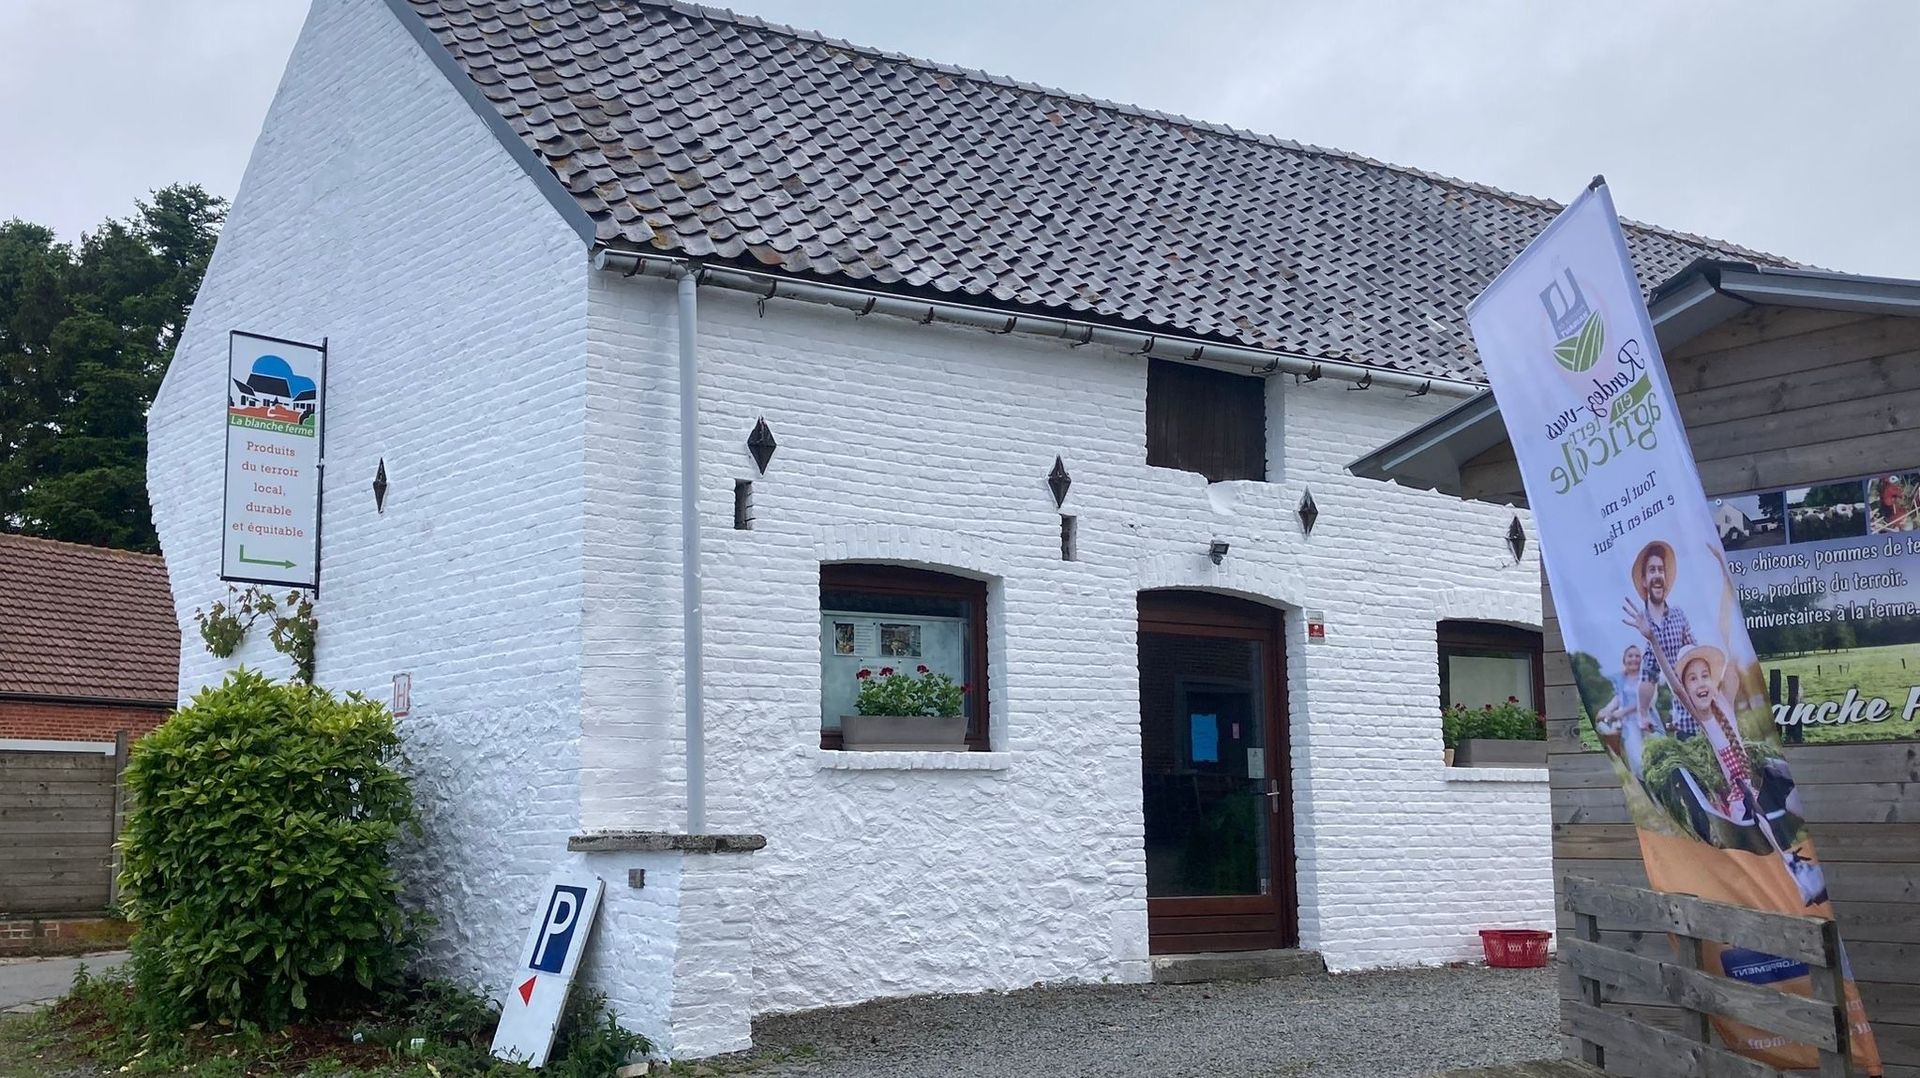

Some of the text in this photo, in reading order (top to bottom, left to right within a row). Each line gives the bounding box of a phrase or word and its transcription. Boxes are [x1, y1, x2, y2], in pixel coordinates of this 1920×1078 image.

[230, 415, 314, 436] La blanche ferme
[247, 441, 296, 457] Produits
[241, 461, 299, 477] du terroir
[254, 482, 286, 497] local,
[245, 502, 292, 516] durable
[232, 522, 304, 538] et équitable
[1728, 560, 1747, 576] ns,
[1752, 551, 1810, 572] chicons,
[1815, 544, 1878, 569] pommes
[1883, 536, 1902, 558] de
[1769, 575, 1826, 603] produits
[1831, 572, 1849, 592] du
[1853, 569, 1907, 590] terroir.
[1745, 598, 1920, 630] nniversaires à la ferme.
[1772, 687, 1891, 726] anche
[533, 890, 578, 966] P
